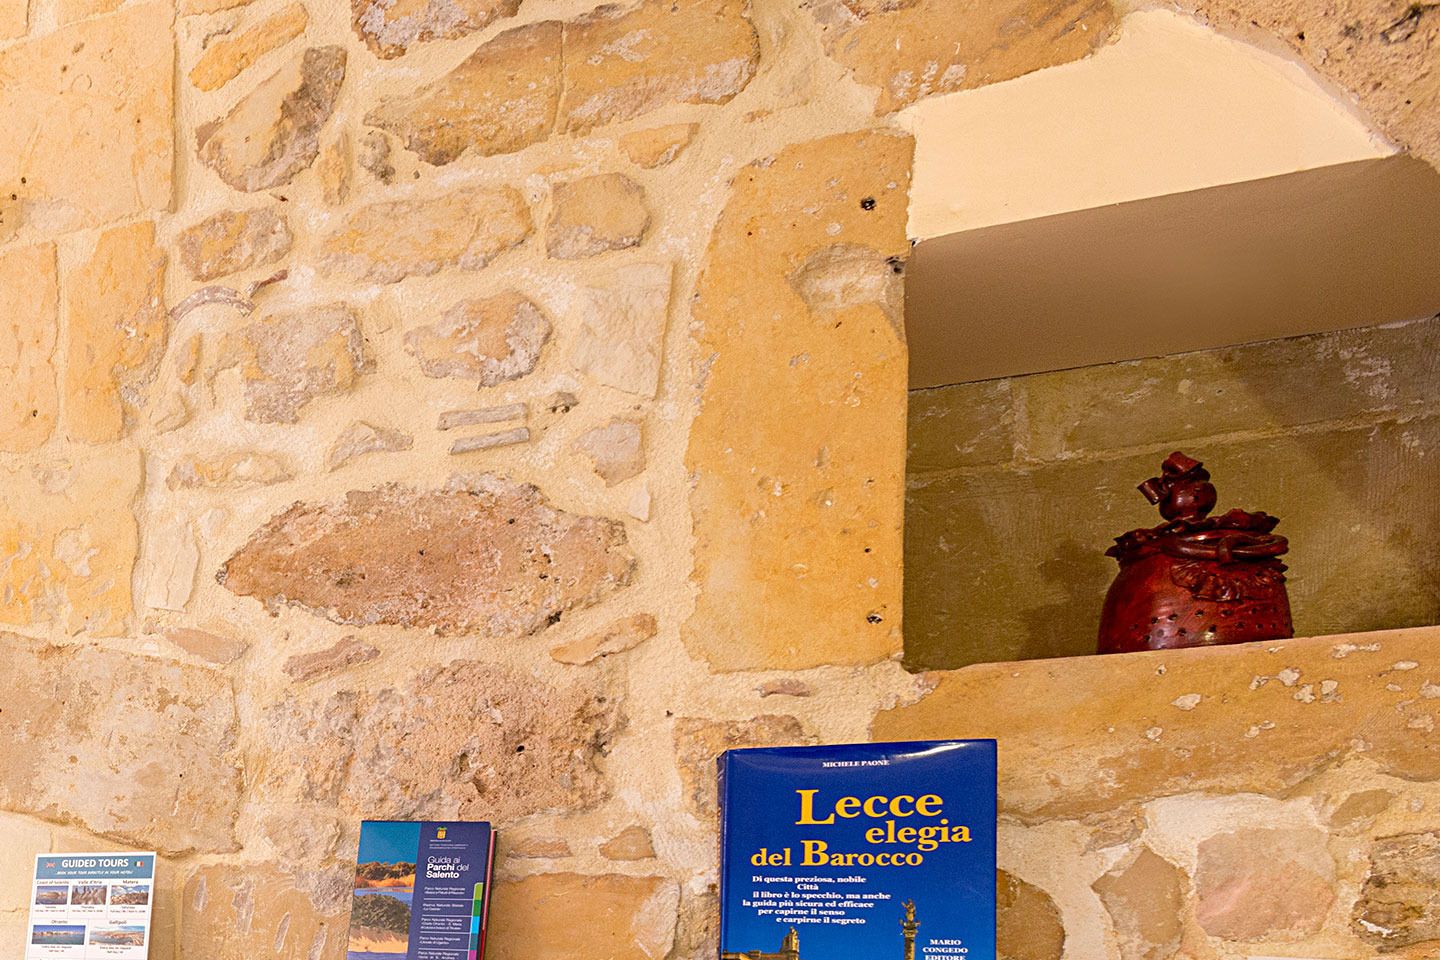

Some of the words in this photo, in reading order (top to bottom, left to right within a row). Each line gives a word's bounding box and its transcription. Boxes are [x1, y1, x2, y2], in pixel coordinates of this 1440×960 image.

[795, 789, 944, 825] Lecce
[865, 819, 973, 851] elegia
[62, 859, 96, 868] GUIDED
[98, 859, 129, 867] TOURS
[750, 848, 792, 866] del
[800, 840, 923, 866] Barocco
